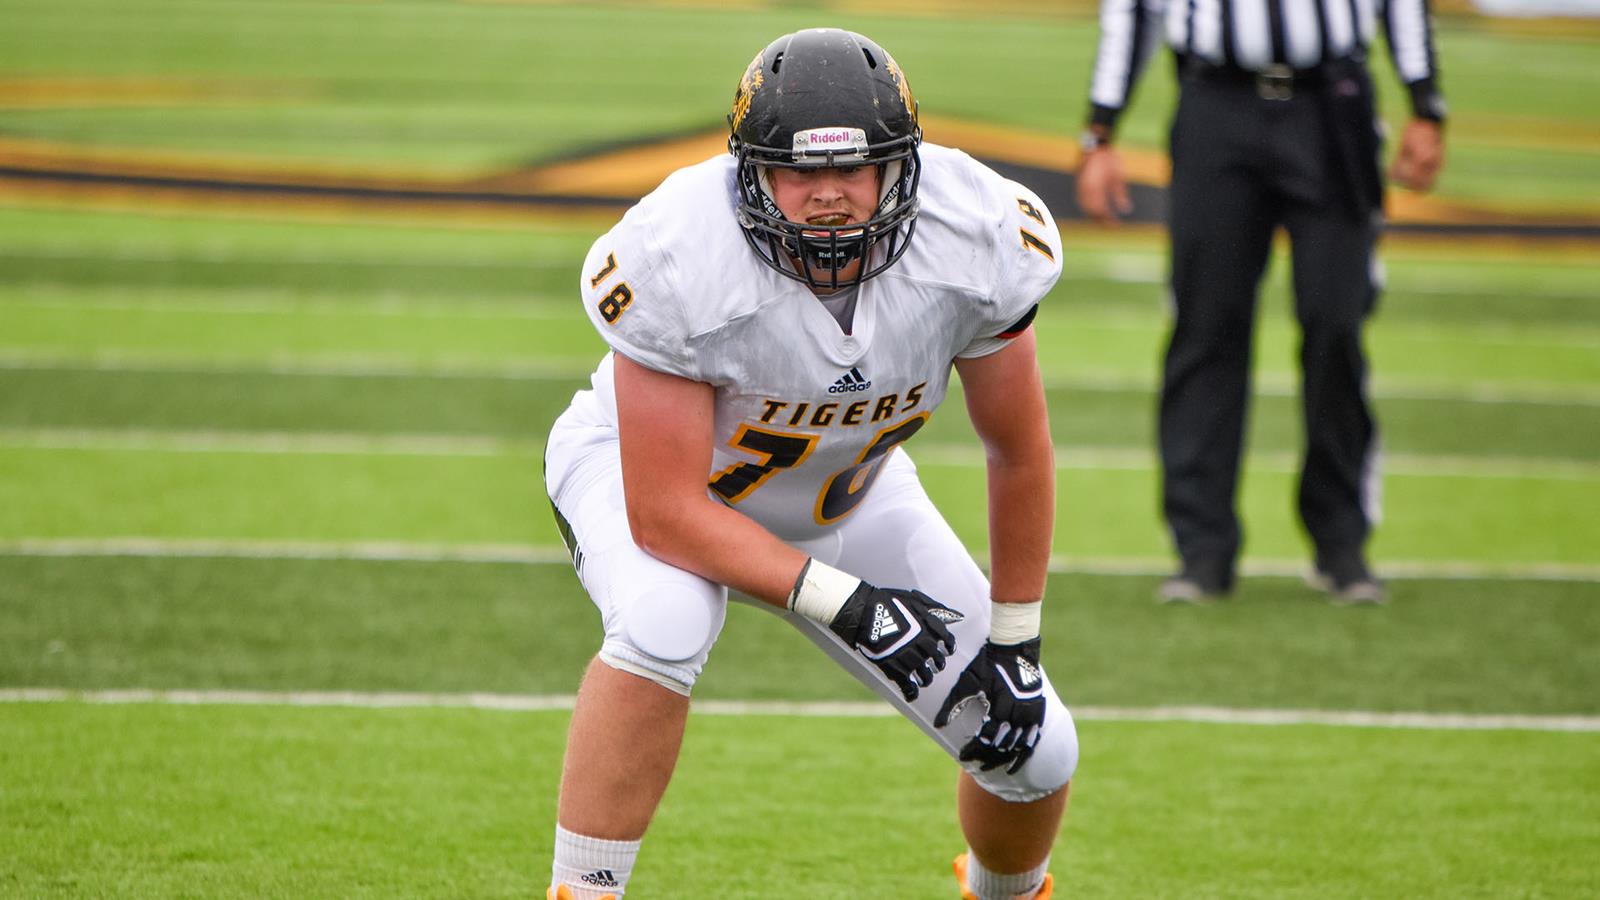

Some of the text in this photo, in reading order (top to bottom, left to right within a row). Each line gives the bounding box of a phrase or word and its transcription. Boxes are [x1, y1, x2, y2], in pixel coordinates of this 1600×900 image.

[810, 131, 849, 143] Riddell
[1016, 196, 1055, 264] 78
[591, 250, 635, 326] 78
[759, 381, 928, 427] TIGERS
[828, 380, 872, 394] adidas
[707, 410, 931, 526] 78
[870, 603, 884, 641] adidas
[581, 874, 618, 888] adidas
